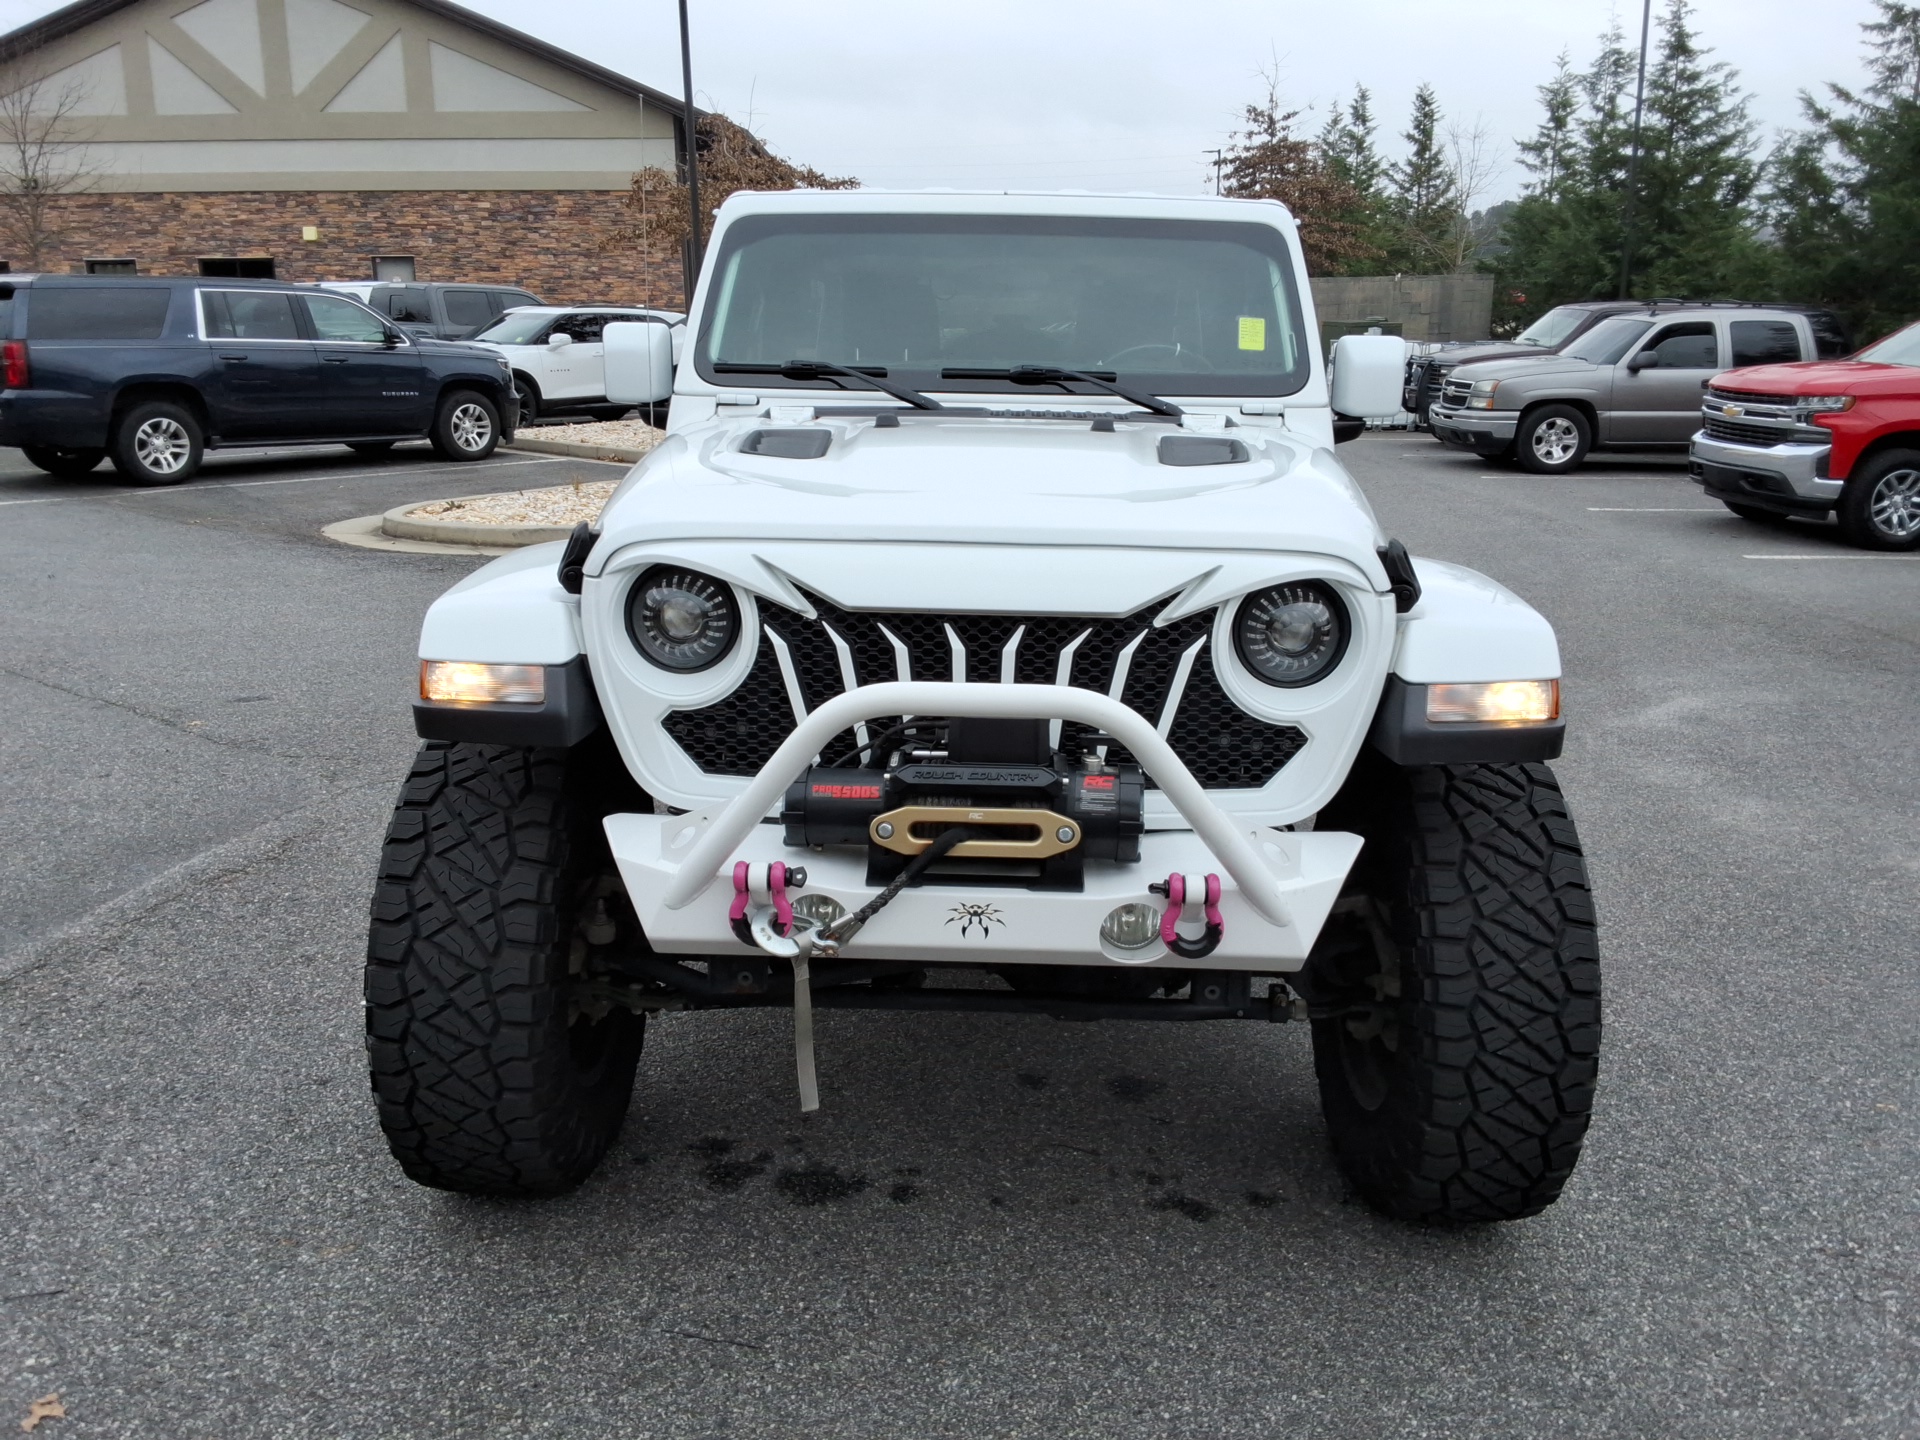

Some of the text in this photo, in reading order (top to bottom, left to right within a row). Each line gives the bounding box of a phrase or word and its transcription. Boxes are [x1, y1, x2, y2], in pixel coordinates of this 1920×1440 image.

[912, 771, 1039, 782] ROUGH COUNTRY
[1083, 775, 1116, 789] RC
[812, 785, 880, 799] PRO 9500S
[968, 812, 984, 820] RC
